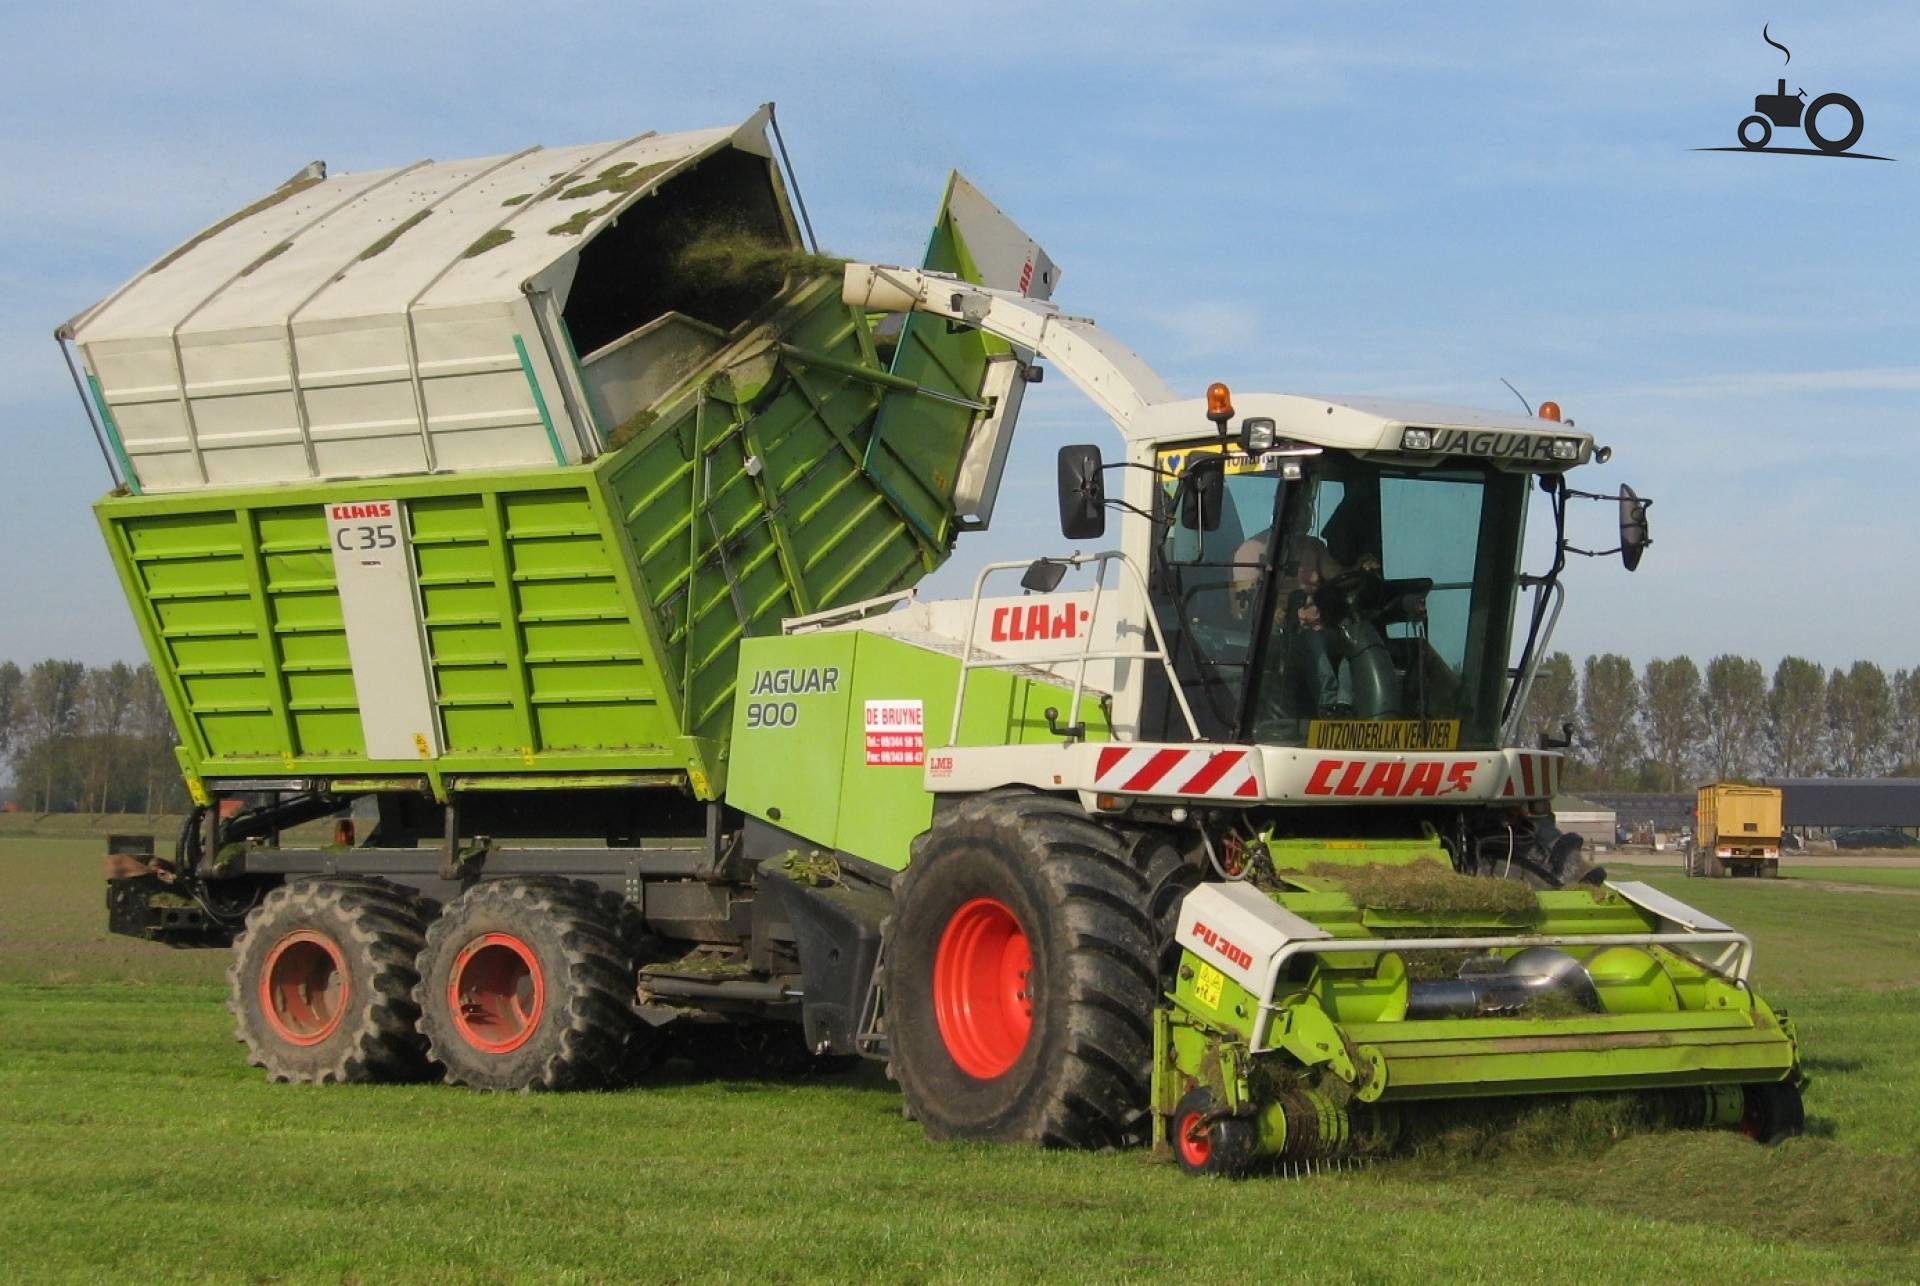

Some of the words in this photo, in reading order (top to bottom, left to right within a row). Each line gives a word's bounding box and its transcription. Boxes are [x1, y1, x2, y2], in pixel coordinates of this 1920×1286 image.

[1432, 430, 1552, 458] JAGUAR
[333, 504, 391, 520] CLAAS
[337, 528, 353, 550] C
[357, 525, 396, 549] 35
[991, 603, 1090, 642] CLAA
[749, 667, 839, 695] JAGUAR
[747, 702, 797, 727] 900
[866, 708, 878, 725] DE
[882, 708, 922, 725] BRUYNE
[1317, 722, 1400, 749] UITZONDERLIJK
[930, 757, 953, 769] LMB
[1304, 760, 1478, 796] CLAAS
